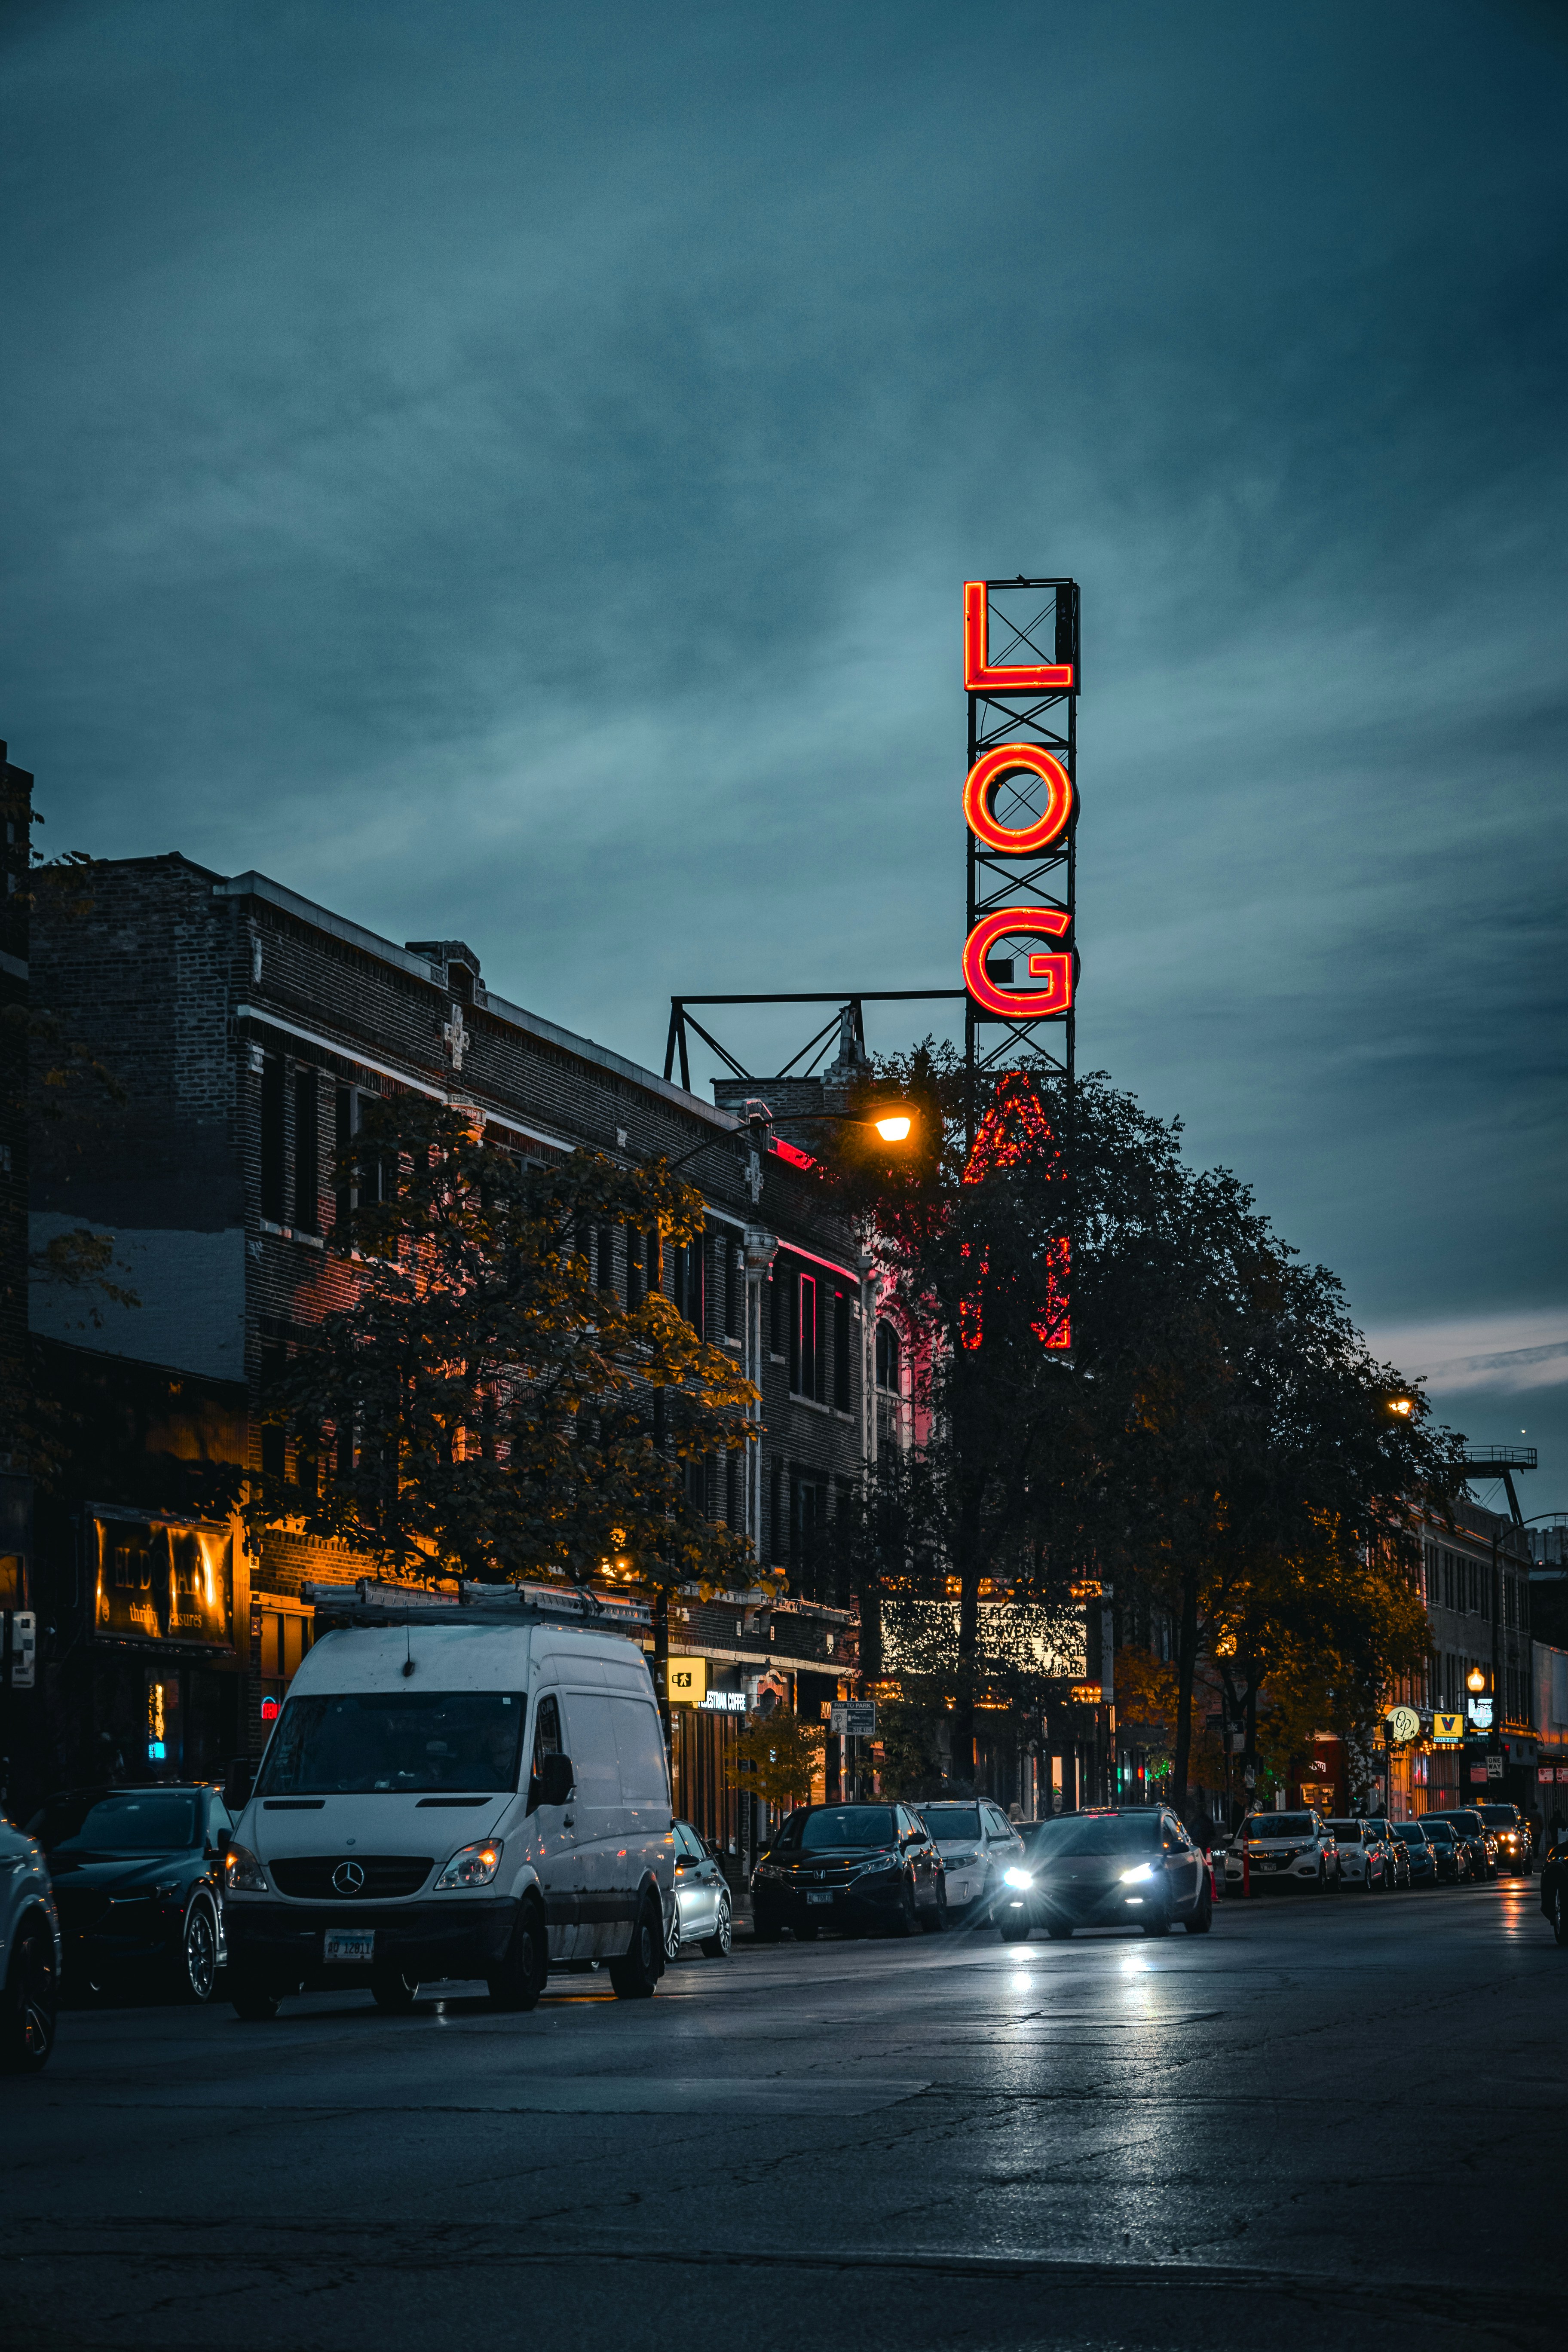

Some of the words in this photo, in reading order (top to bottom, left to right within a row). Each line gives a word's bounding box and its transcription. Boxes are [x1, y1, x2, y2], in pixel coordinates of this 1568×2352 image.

[115, 1547, 134, 1588] EL
[129, 1602, 159, 1631] thrifty
[165, 1612, 202, 1628] easures
[698, 1690, 727, 1710] ESTRIAN
[727, 1692, 746, 1711] COFFEE
